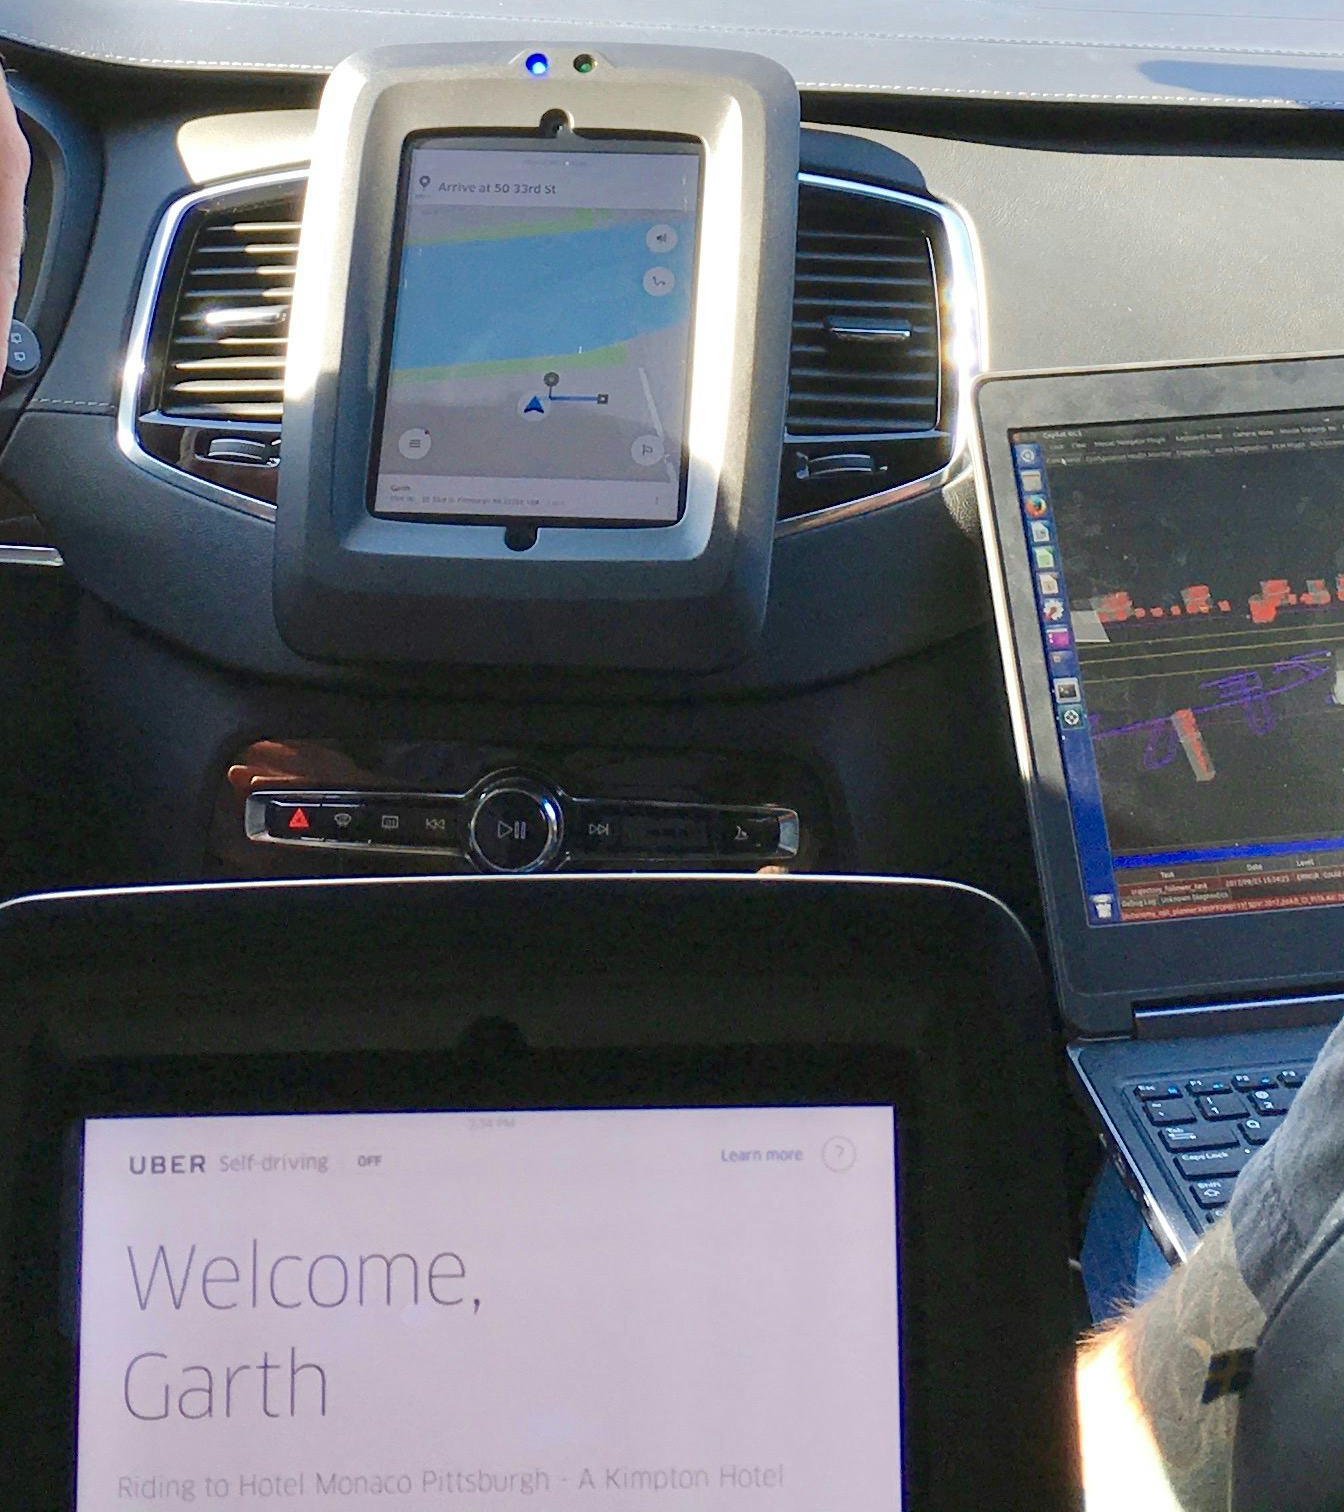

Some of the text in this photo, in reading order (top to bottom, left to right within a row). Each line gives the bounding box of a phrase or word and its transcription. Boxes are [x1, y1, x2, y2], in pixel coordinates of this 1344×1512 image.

[438, 182, 557, 195] Arrive at 50 33rd St
[1166, 1126, 1185, 1134] Tab
[1246, 1119, 1261, 1129] Q
[720, 1148, 804, 1163] Learn more
[1181, 1151, 1229, 1162] Caps Lock
[128, 1153, 383, 1175] UBER Self-driving OFF
[1197, 1180, 1222, 1189] Shift
[125, 1238, 482, 1315] Welcome,
[123, 1346, 328, 1421] Garth
[117, 1475, 197, 1503] Riding
[205, 1476, 229, 1498] to
[239, 1473, 305, 1497] Hotel
[315, 1471, 412, 1496] Monaco
[421, 1468, 550, 1495] Pittsburgh
[578, 1467, 596, 1490] A
[605, 1465, 710, 1491] Kimpton
[719, 1463, 784, 1488] Hotel
